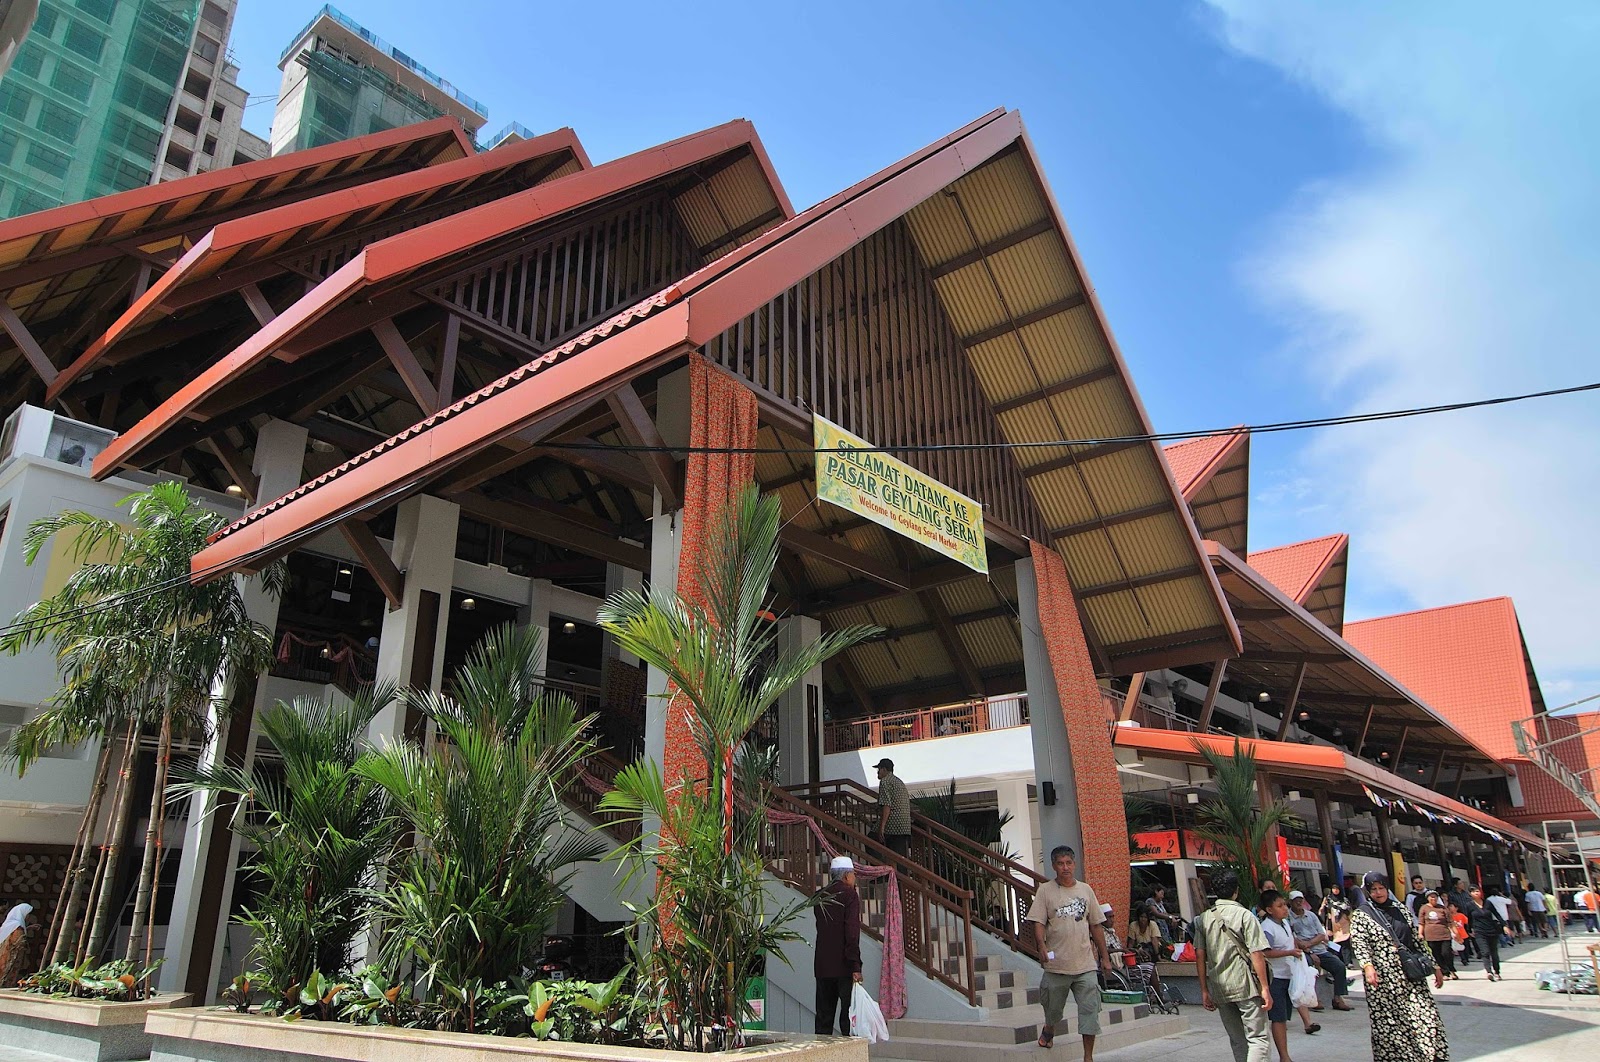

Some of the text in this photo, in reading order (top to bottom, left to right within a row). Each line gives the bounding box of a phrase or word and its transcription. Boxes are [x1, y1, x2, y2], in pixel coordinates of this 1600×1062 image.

[827, 456, 978, 548] PASAR GEYLANG SERAI
[837, 440, 969, 523] SELAMAT DATANG KE
[859, 495, 889, 517] Welcome
[890, 510, 897, 521] to
[898, 514, 922, 535] Geylang
[923, 526, 938, 541] Serai
[1167, 839, 1175, 854] 2
